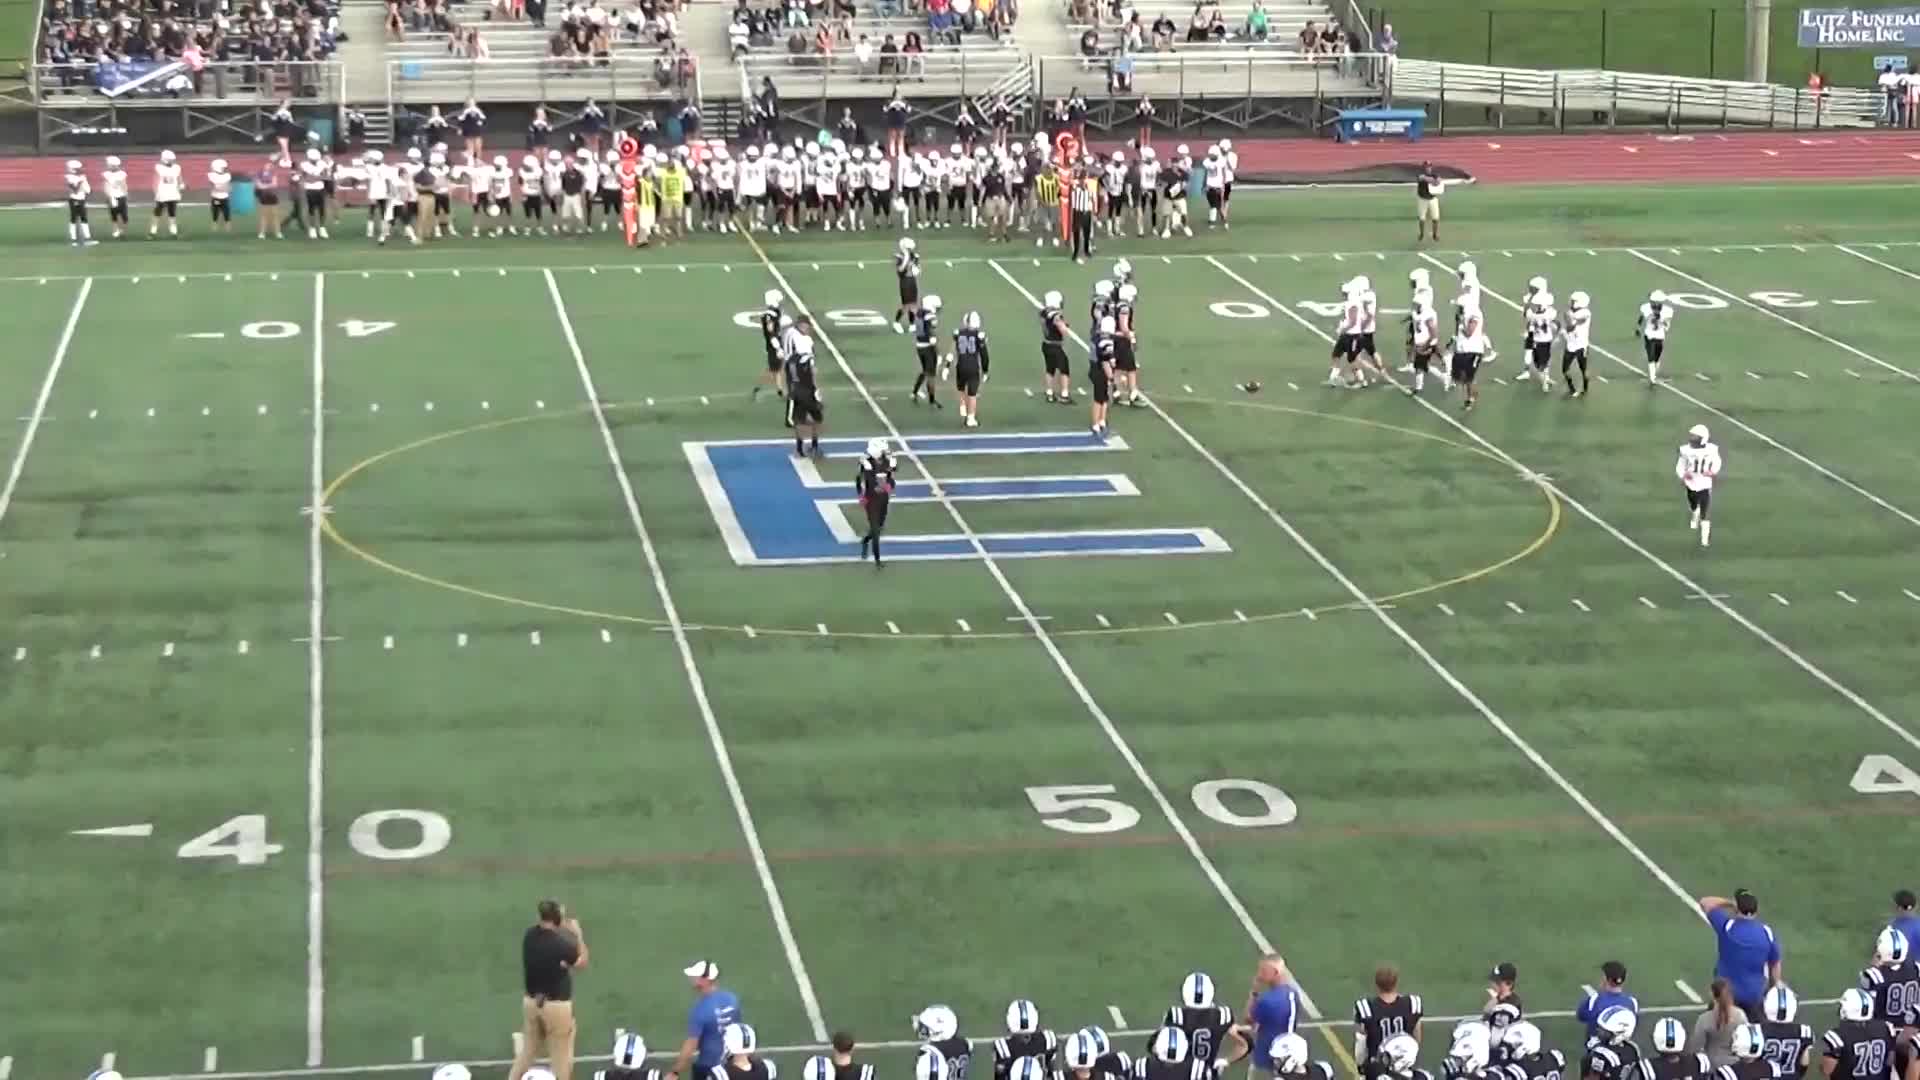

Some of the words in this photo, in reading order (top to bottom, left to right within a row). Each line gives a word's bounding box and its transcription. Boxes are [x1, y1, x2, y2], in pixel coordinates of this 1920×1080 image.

[1803, 10, 1845, 26] LUTZ
[1886, 981, 1920, 1016] 80
[1192, 1028, 1211, 1060] 6
[1763, 1038, 1801, 1074] 27
[1852, 1039, 1886, 1077] 78
